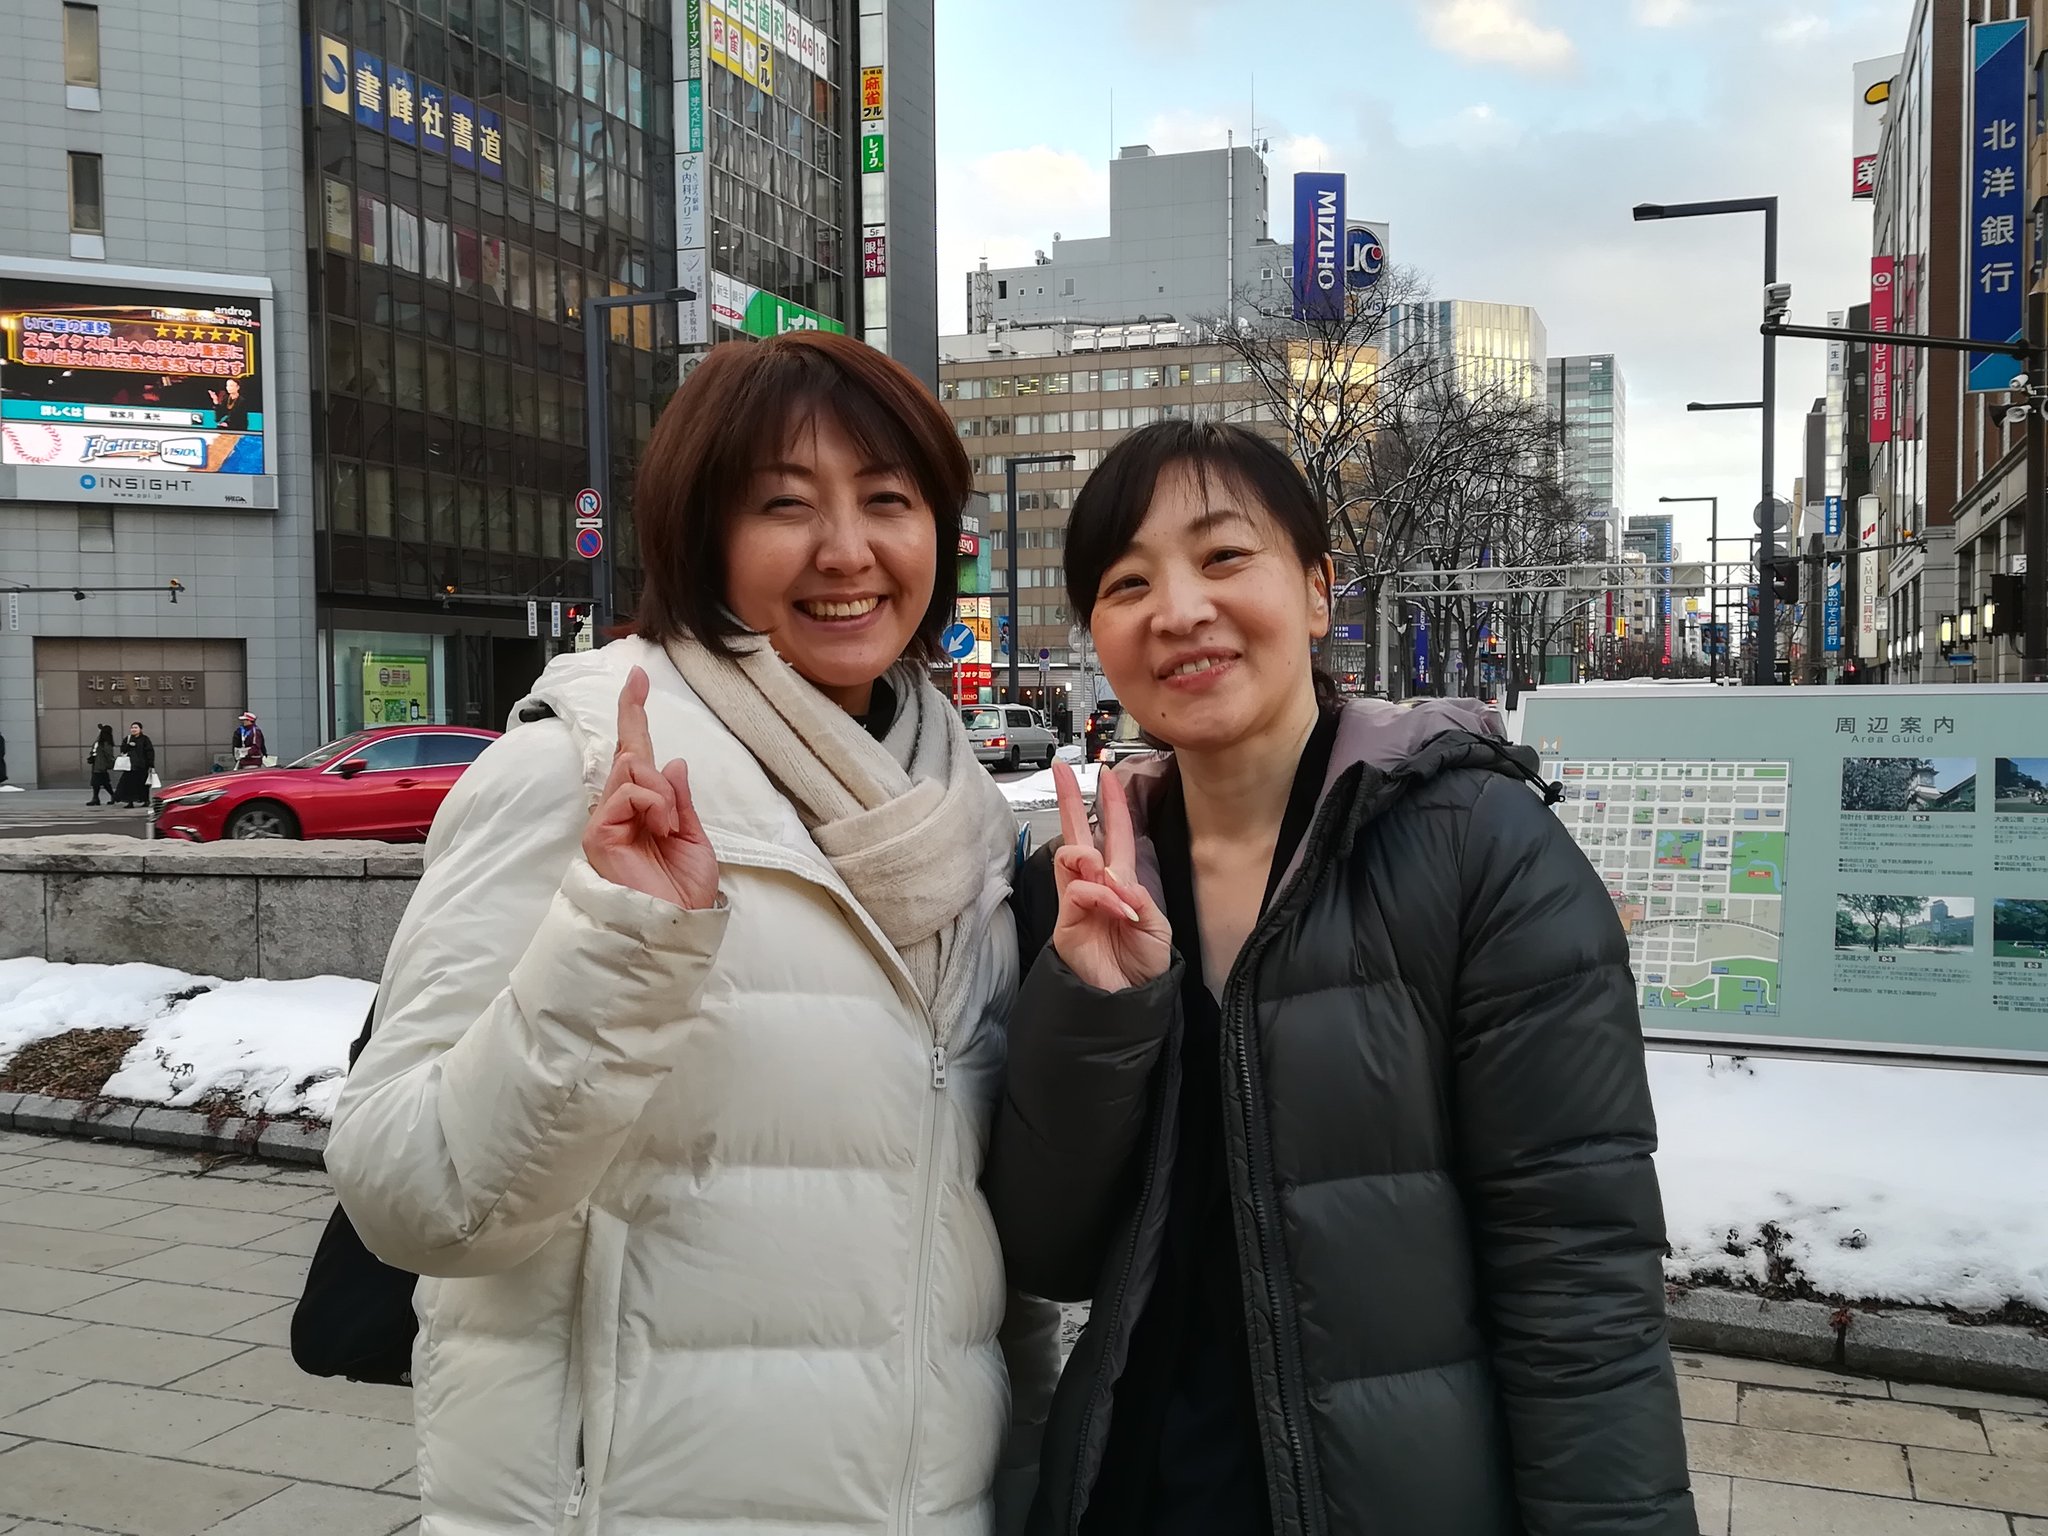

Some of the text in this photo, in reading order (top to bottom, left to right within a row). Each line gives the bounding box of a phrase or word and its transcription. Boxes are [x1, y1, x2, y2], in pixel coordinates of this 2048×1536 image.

[689, 0, 701, 79] ンツーマン英会話
[865, 76, 881, 105] 麻雀
[356, 68, 502, 165] 書峰社書道
[869, 138, 879, 168] レイク
[682, 172, 693, 246] 内科クリニック
[1980, 119, 2017, 294] 北洋銀行
[870, 228, 880, 236] 5F
[1318, 190, 1336, 290] MIZUHO
[865, 241, 877, 273] 眼科
[23, 316, 112, 335] いて座の運勢
[214, 305, 253, 318] androp
[1873, 316, 1888, 421] 三UFJ信託銀行
[79, 434, 198, 462] FIGHTERS VISION
[100, 477, 192, 492] INSIGHT
[1863, 555, 1874, 634] SMBC日興証券
[1827, 587, 1839, 646] あおぞら銀行
[88, 675, 196, 690] 北海道銀行
[1835, 716, 1954, 734] 周辺案内
[1851, 735, 1934, 744] Area Guide
